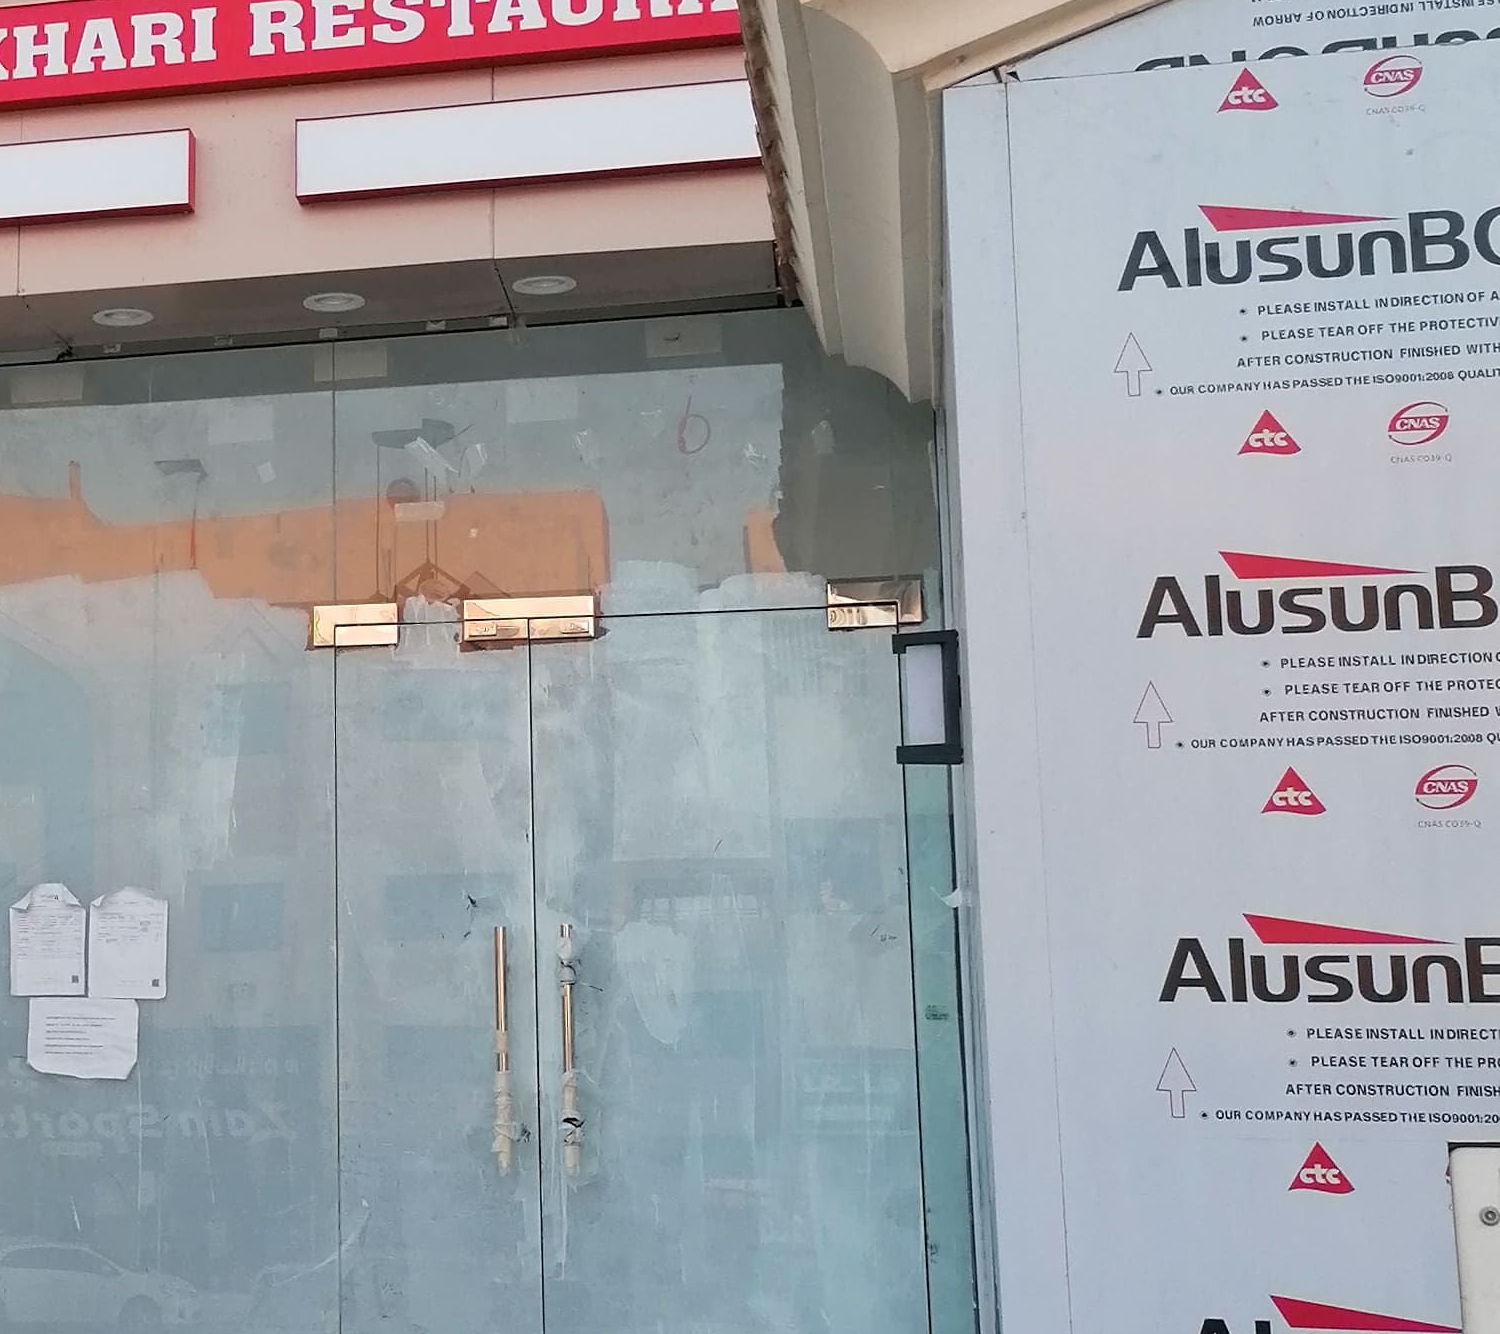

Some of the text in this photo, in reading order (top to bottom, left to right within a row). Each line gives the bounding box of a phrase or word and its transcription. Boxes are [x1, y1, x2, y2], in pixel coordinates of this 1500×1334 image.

[1252, 12, 1302, 28] ARROW
[1305, 10, 1325, 24] OF
[1370, 69, 1415, 84] CNAS
[1257, 301, 1312, 316] PLEASE
[1313, 298, 1370, 314] INSTALL
[1466, 290, 1485, 303] OF
[1261, 326, 1315, 341] PLEASE
[1318, 324, 1355, 339] TEAR
[1357, 322, 1385, 336] OFF
[1389, 320, 1417, 334] THE
[1237, 353, 1281, 369] AFTER
[1284, 348, 1393, 366] CONSTRUCTION
[1400, 344, 1461, 360] FINISHED
[1169, 384, 1194, 396] OUR
[1198, 381, 1261, 395] COMPANY
[1292, 376, 1343, 389] PASSED
[1345, 375, 1371, 387] THE
[1394, 416, 1441, 431] CNAS
[1248, 428, 1288, 449] ctc
[1136, 565, 1500, 638] AlusunB
[1280, 656, 1335, 669] PLEASE
[1338, 654, 1396, 668] INSTALL
[1284, 682, 1339, 696] PLEASE
[1342, 681, 1380, 695] TEAR
[1383, 680, 1411, 693] OFF
[1416, 679, 1443, 693] THE
[1259, 705, 1490, 723] AFTER CONSTRUCTION FINISHED
[1191, 737, 1216, 749] OUR
[1220, 736, 1284, 749] COMPANY
[1286, 735, 1315, 747] HAS
[1316, 734, 1369, 747] PASSED
[1371, 733, 1397, 746] THE
[1422, 780, 1469, 795] CNAS
[1272, 786, 1313, 807] ctc
[1306, 1027, 1363, 1040] PLEASE
[1366, 1027, 1426, 1041] INSTALL
[1311, 1055, 1474, 1069] PLEASE TEAR OFF THE
[1285, 1083, 1332, 1097] AFTER
[1335, 1083, 1450, 1098] CONSTRUCTION
[1215, 1109, 1427, 1124] OUR COMPANY HAS PASSED THE
[1299, 1163, 1342, 1185] ctc
